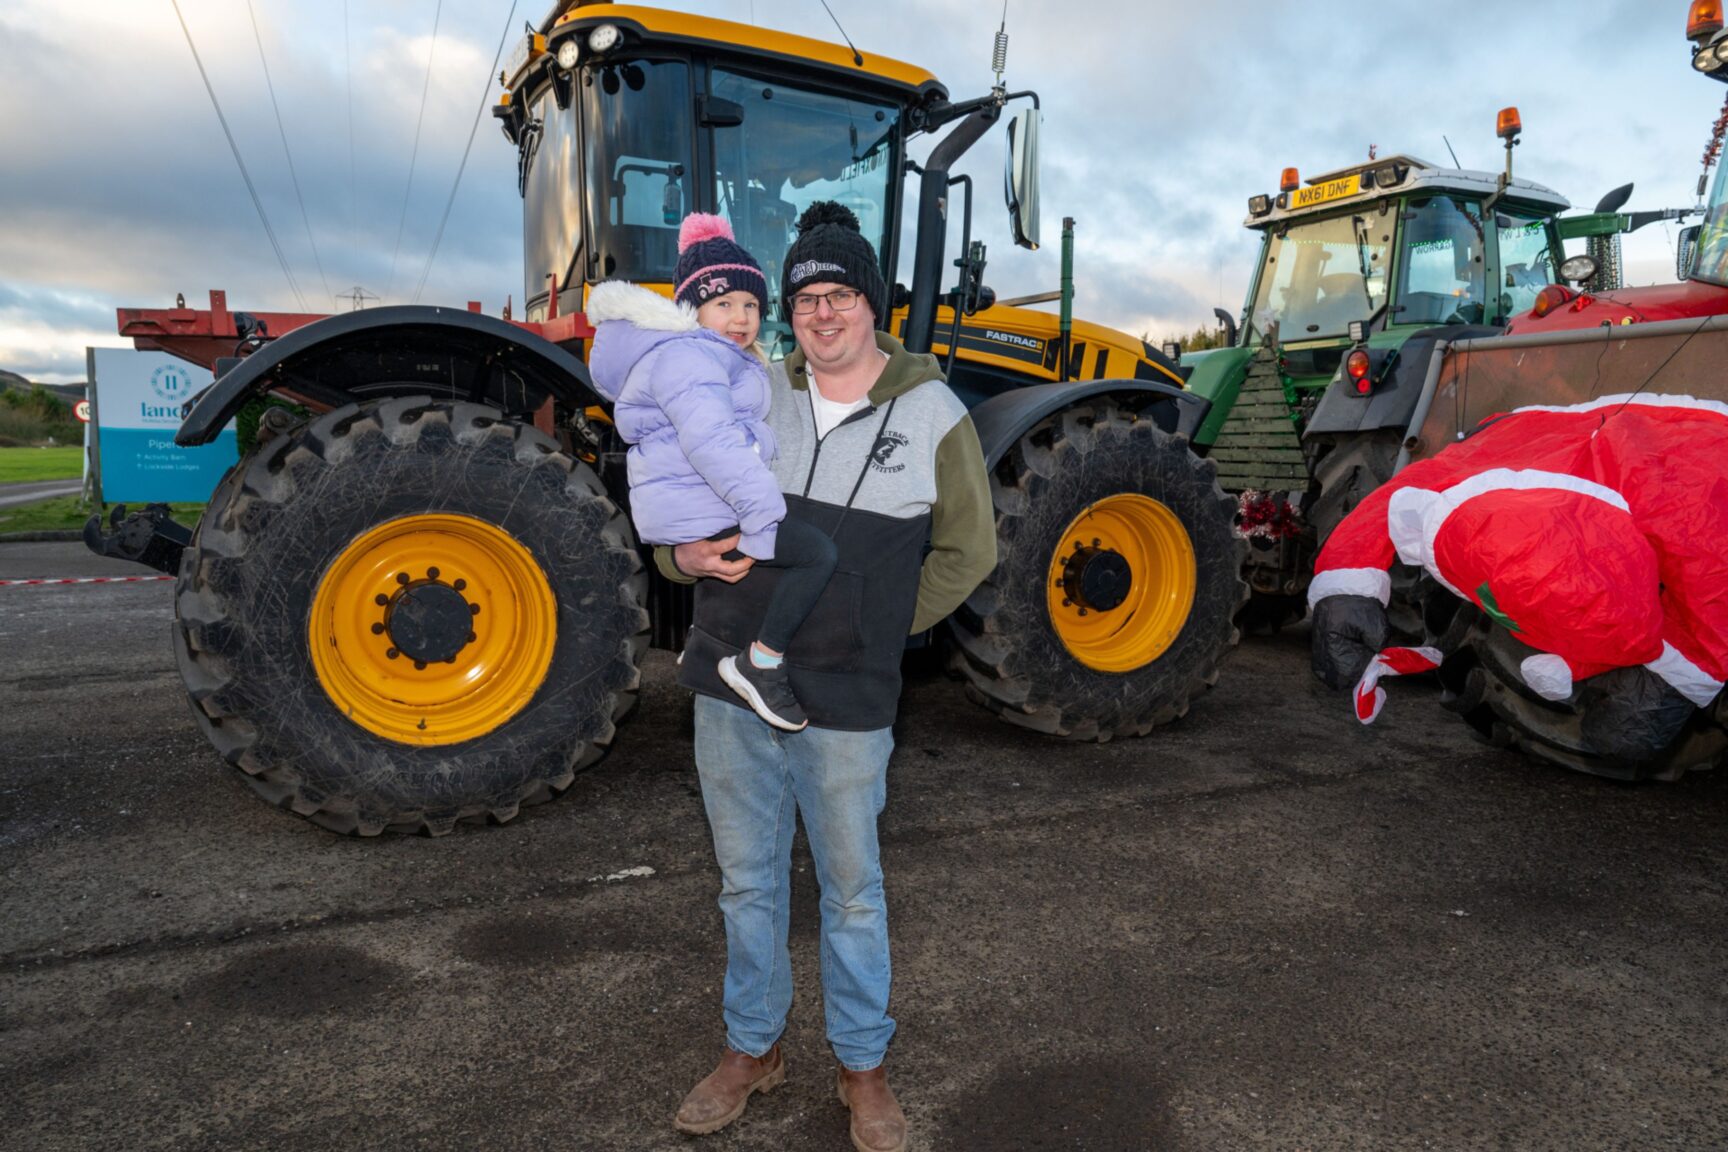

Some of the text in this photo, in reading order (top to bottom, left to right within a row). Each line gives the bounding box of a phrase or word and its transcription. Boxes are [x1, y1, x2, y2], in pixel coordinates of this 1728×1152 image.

[1299, 179, 1351, 205] NX61 DNF
[986, 330, 1037, 348] FASTRAC
